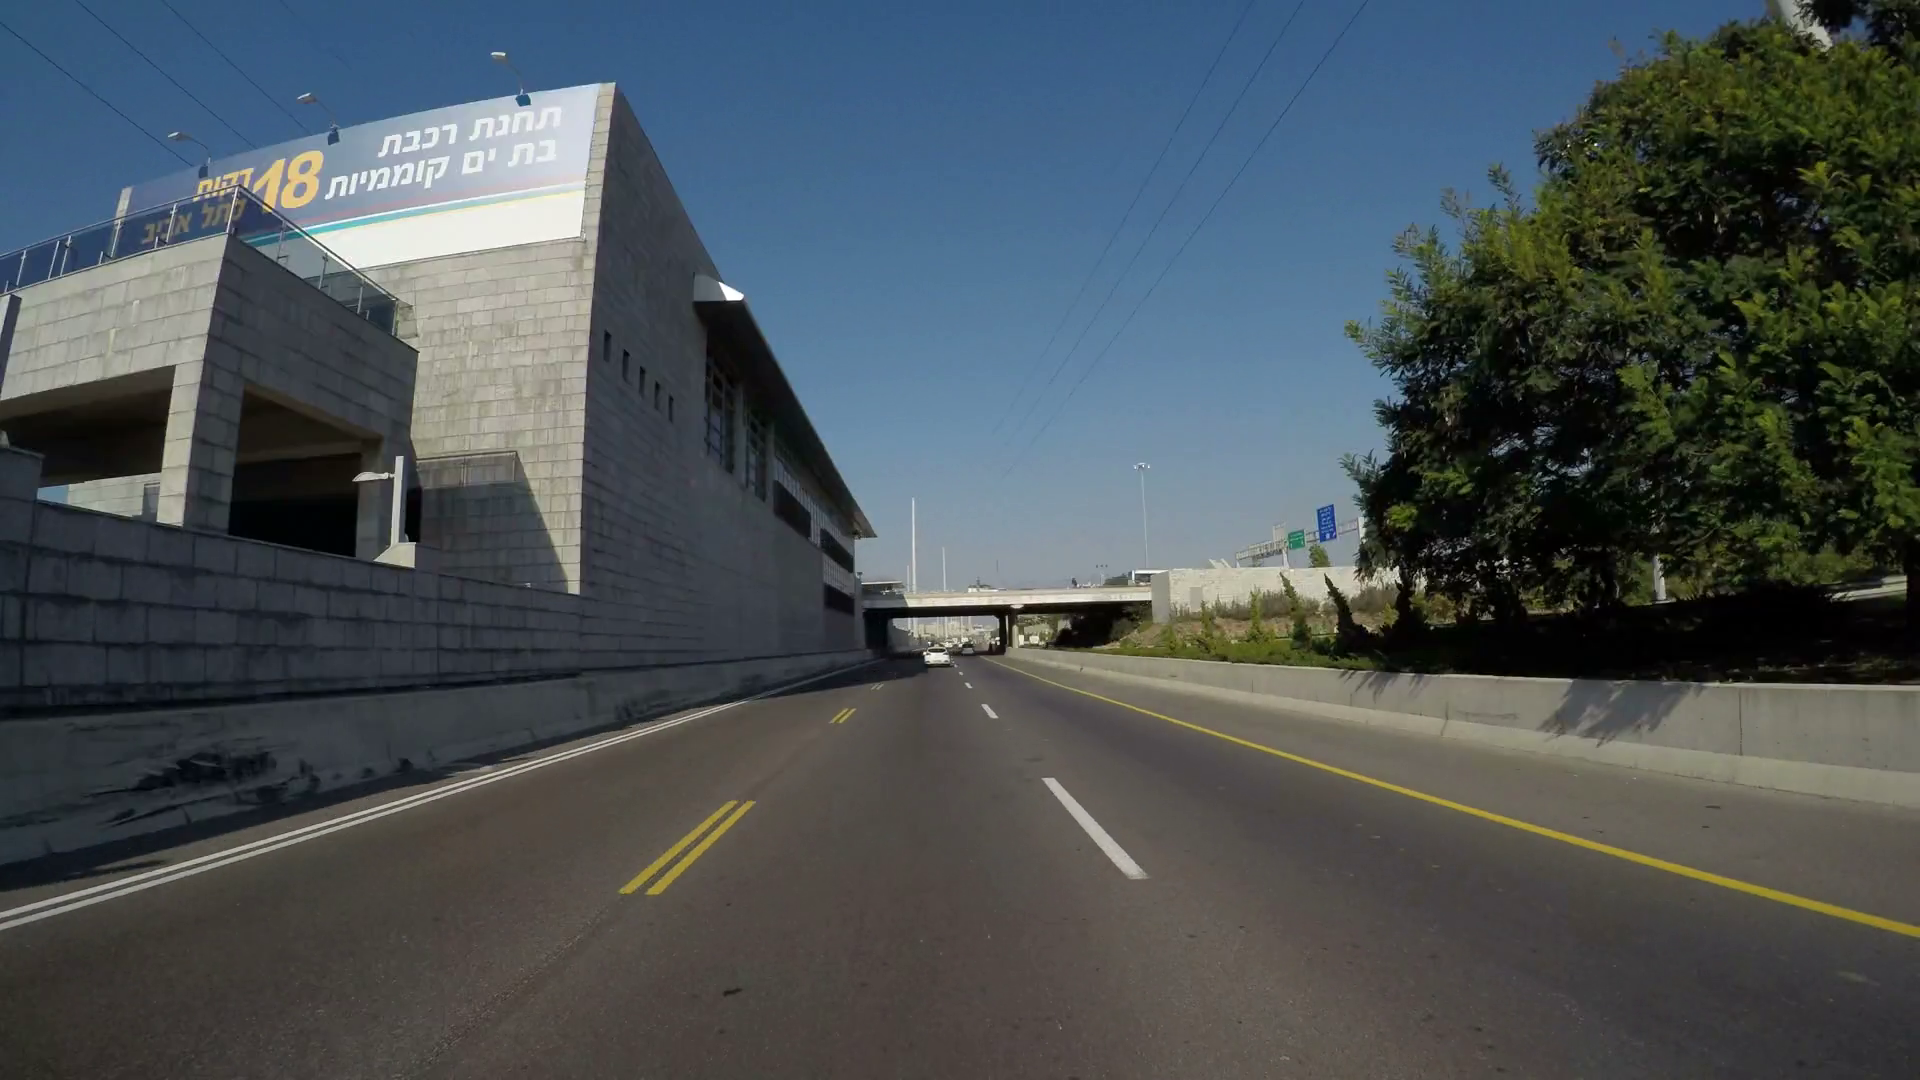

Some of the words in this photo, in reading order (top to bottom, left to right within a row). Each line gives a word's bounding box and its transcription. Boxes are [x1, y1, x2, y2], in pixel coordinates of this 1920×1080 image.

[378, 123, 458, 157] רכבת
[470, 106, 562, 141] תחנת
[461, 148, 496, 175] ים
[507, 139, 557, 168] בת
[193, 168, 254, 202] דקות
[252, 150, 324, 213] 18
[325, 157, 450, 200] קוממיות
